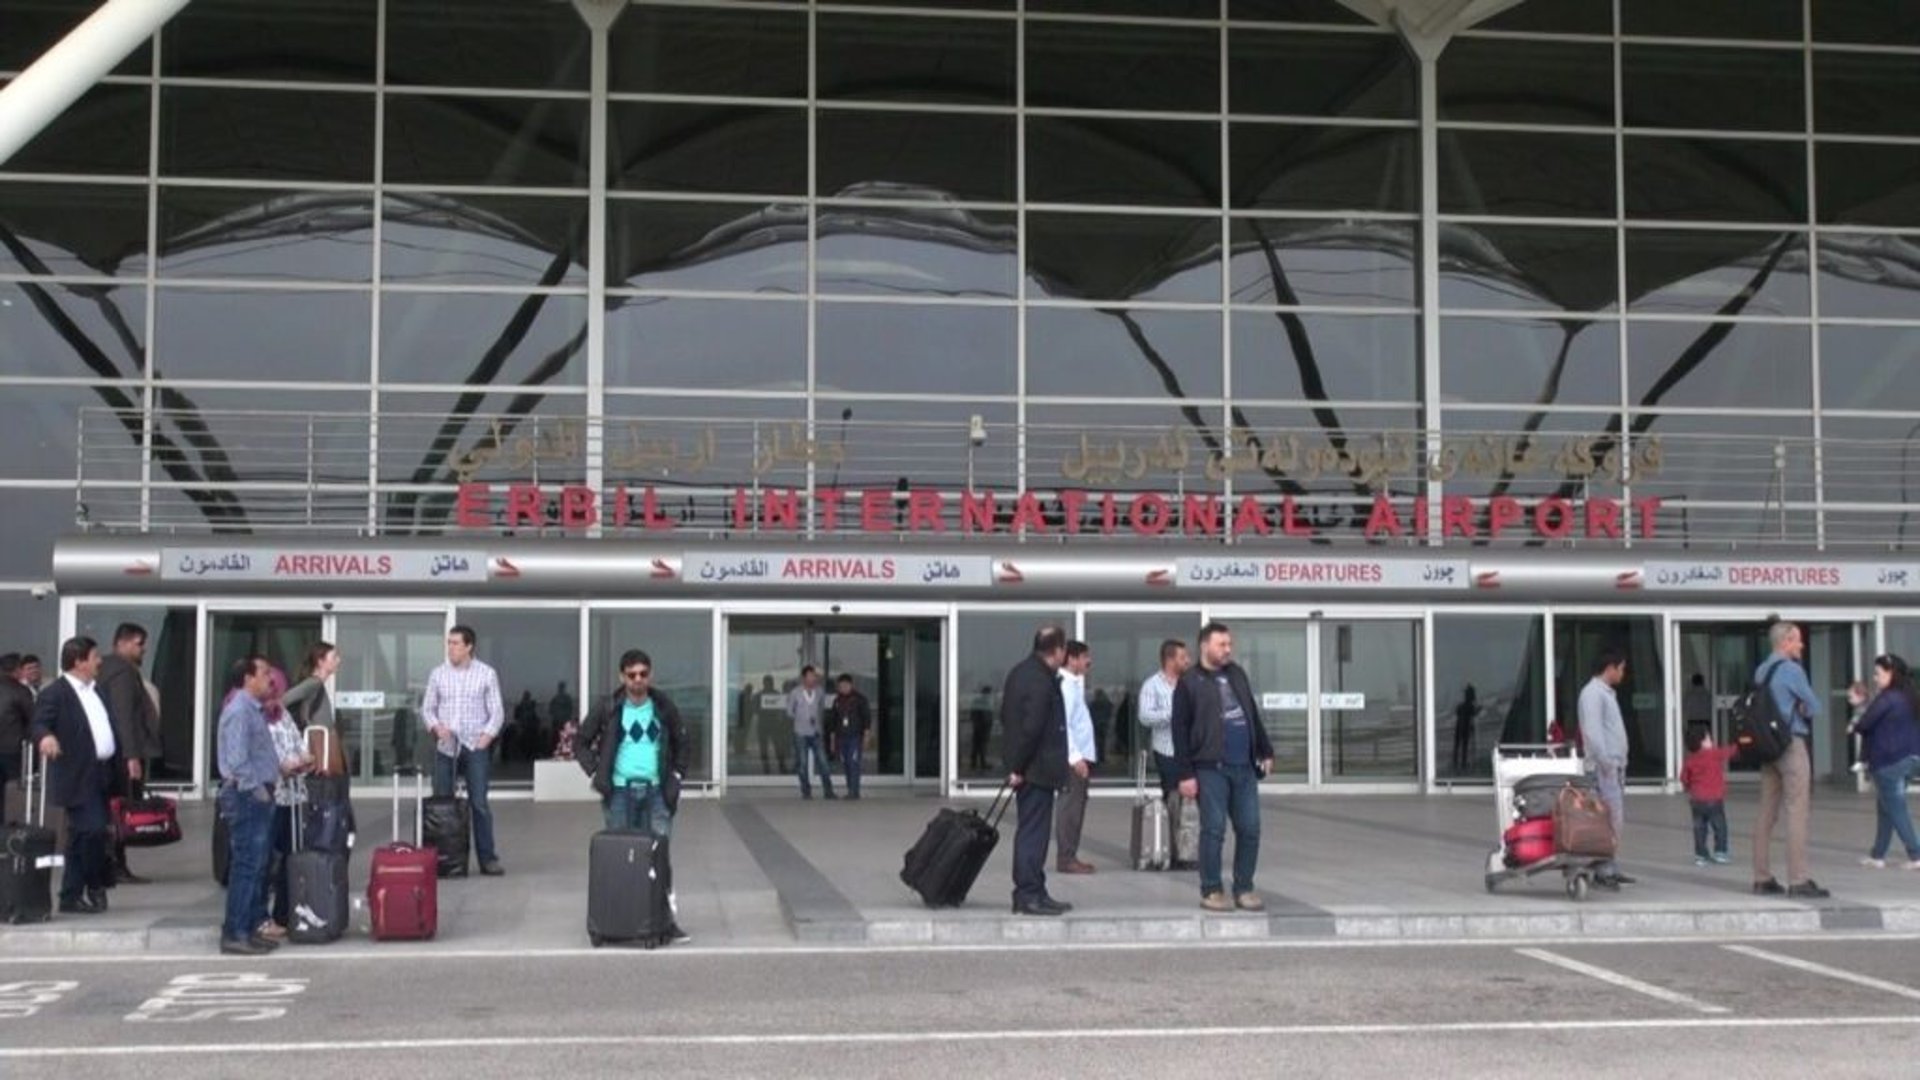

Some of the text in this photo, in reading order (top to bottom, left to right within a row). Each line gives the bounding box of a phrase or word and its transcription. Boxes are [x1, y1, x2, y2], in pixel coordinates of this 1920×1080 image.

[456, 483, 1661, 539] ERBIL INTERNATIONAL AIRPORT
[274, 555, 392, 576] ARRIVALS
[700, 559, 769, 579] القادمون
[781, 558, 895, 580] ARRIVALS
[1264, 563, 1382, 583] DEPARTURES
[1728, 566, 1841, 586] DEPARTURES
